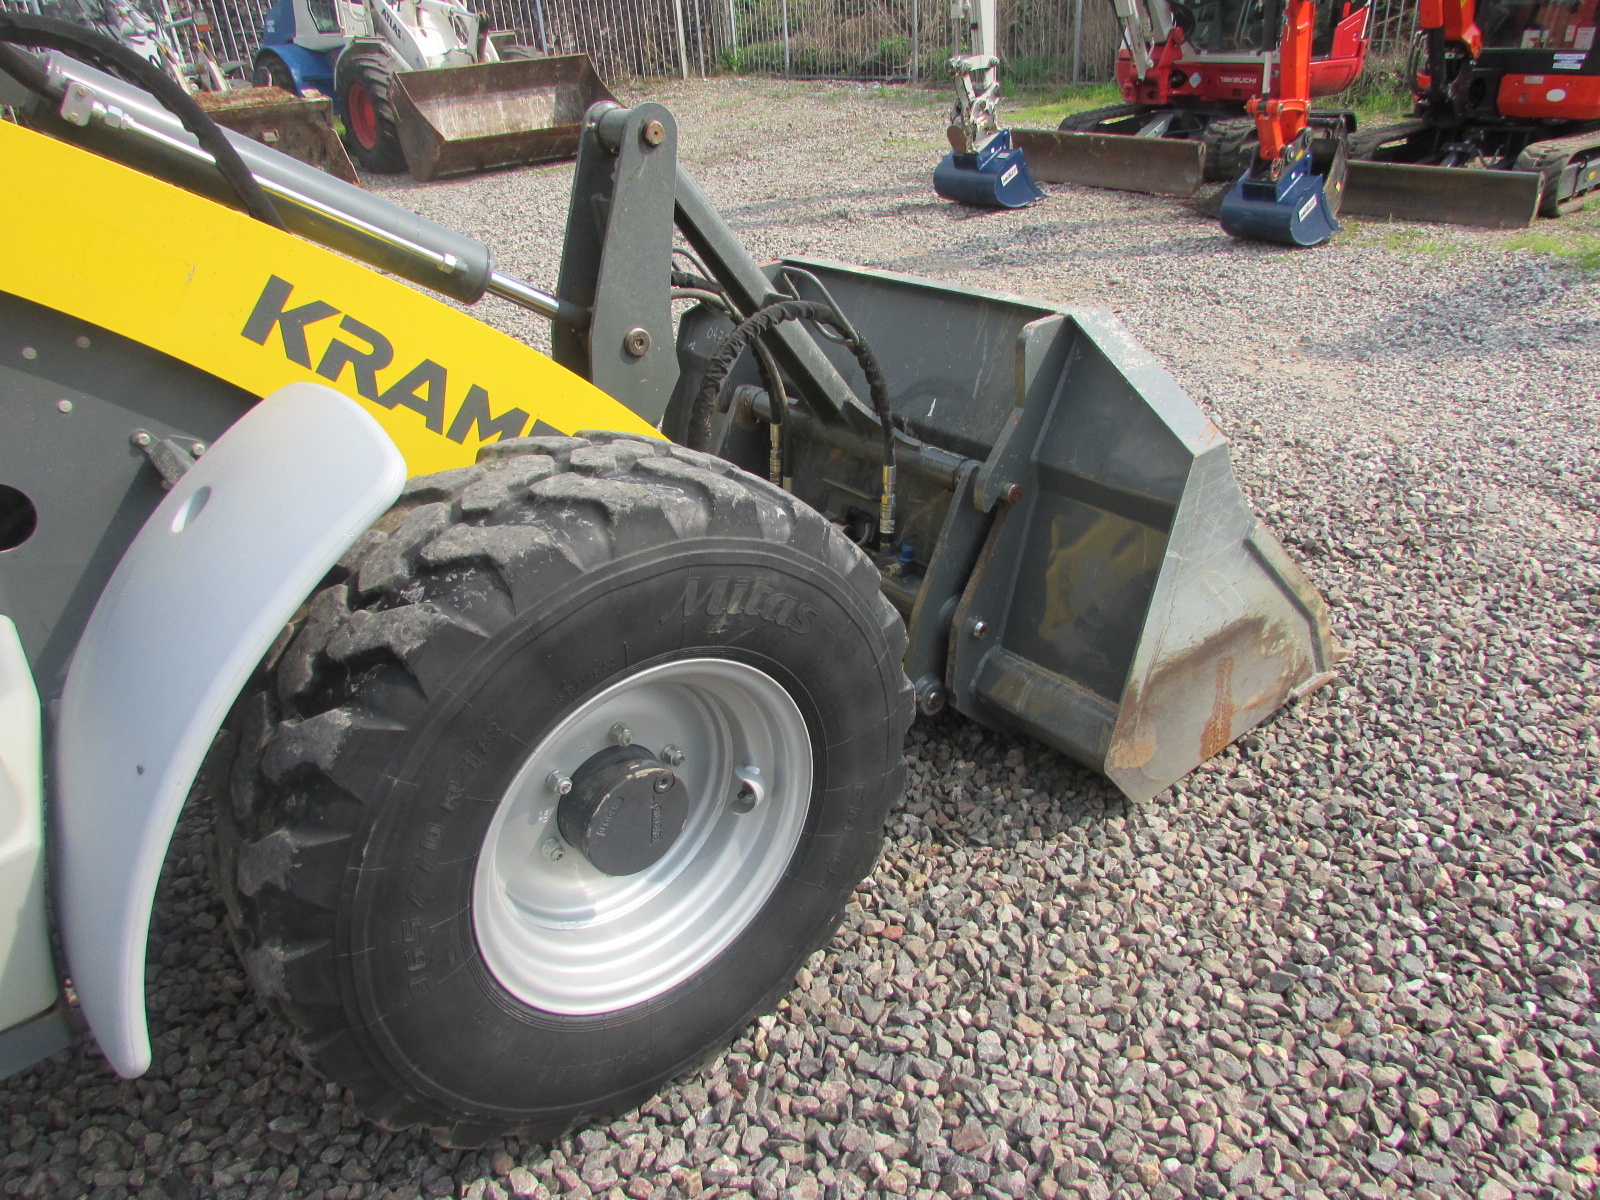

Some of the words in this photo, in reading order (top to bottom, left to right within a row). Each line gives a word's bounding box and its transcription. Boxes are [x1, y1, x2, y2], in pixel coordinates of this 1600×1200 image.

[381, 8, 402, 39] ATLAS
[241, 274, 572, 445] KRAM
[659, 575, 820, 635] Mitas
